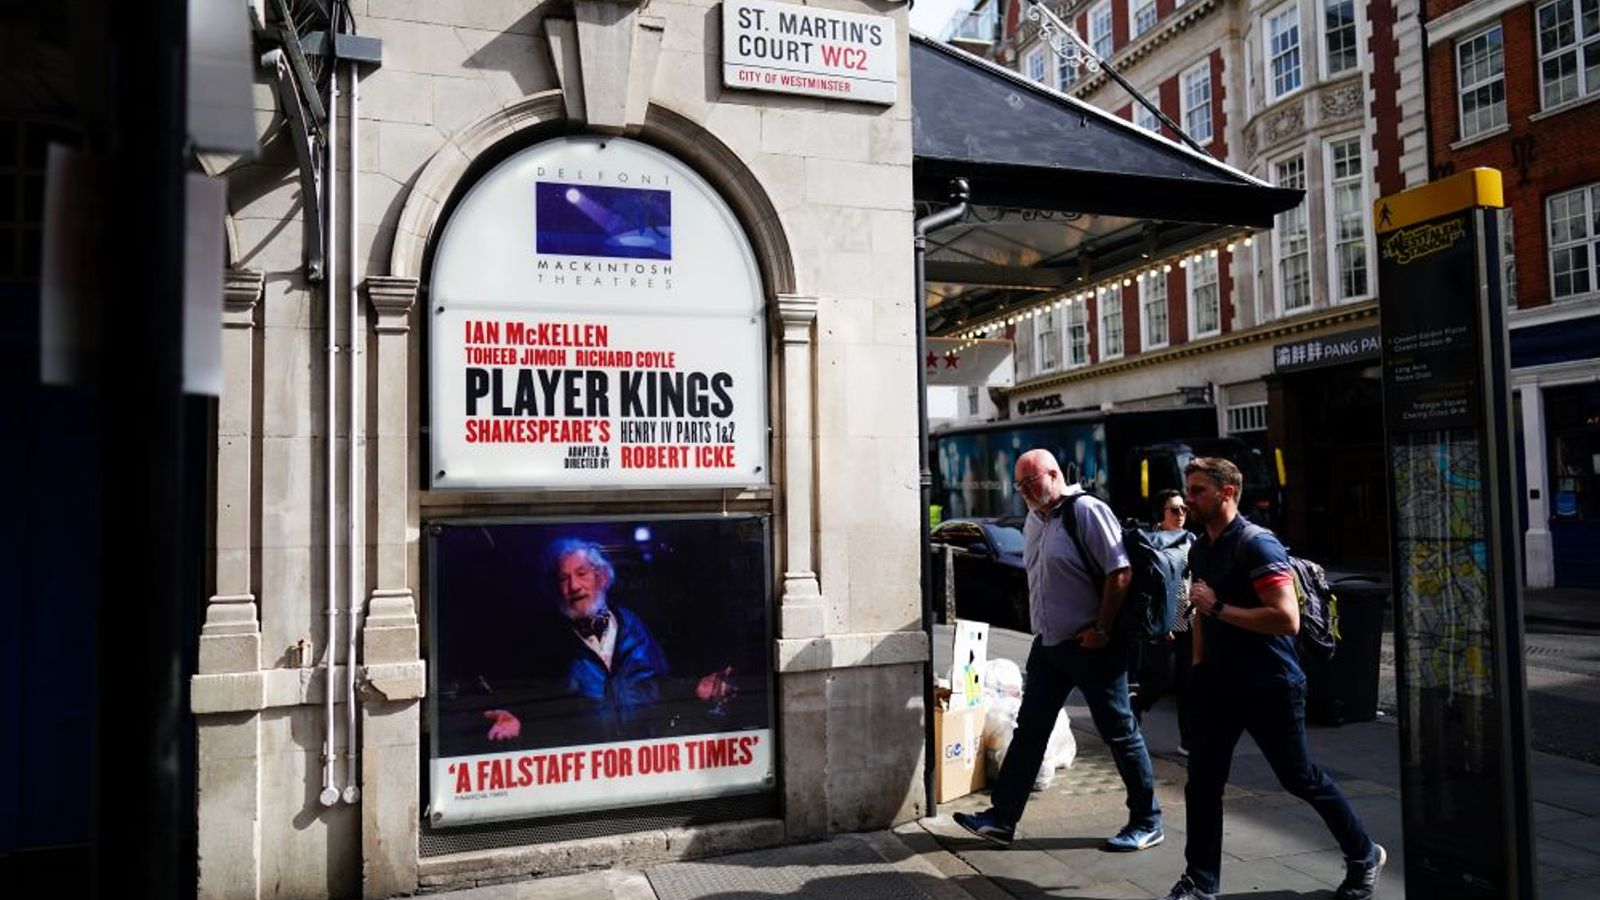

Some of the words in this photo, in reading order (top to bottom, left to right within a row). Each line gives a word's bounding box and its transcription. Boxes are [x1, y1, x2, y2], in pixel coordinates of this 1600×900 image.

[738, 7, 769, 32] ST.
[779, 12, 883, 46] MARTIN'S
[738, 34, 813, 65] COURT
[821, 44, 868, 71] WC2
[738, 69, 762, 82] CITY
[764, 72, 777, 84] OF
[780, 76, 852, 93] WESTMINSTER
[537, 259, 672, 275] MACKINTOSH
[537, 273, 672, 290] THEATRES
[465, 320, 499, 345] IAN
[505, 321, 608, 348] McKELLEN
[464, 347, 517, 366] TOHEEB
[520, 348, 567, 367] JIMOH
[575, 350, 633, 368] RICHARD
[636, 351, 676, 369] COYLE
[1324, 340, 1359, 358] PANG
[465, 367, 609, 418] PLAYER
[619, 370, 735, 419] KINGS
[465, 419, 611, 444] SHAKESPEARE'S
[620, 421, 656, 443] HENRY
[660, 421, 672, 443] IV
[676, 421, 711, 444] PARTS
[716, 421, 735, 444] 1&2
[568, 445, 600, 457] ADAPTED
[602, 446, 609, 457] &
[620, 446, 689, 469] ROBERT
[695, 446, 735, 468] ICKE
[564, 457, 598, 469] DIRECTED
[600, 458, 610, 469] BY
[477, 752, 586, 791] FALSTAFF
[592, 749, 632, 779] FOR
[638, 743, 680, 774] OUR
